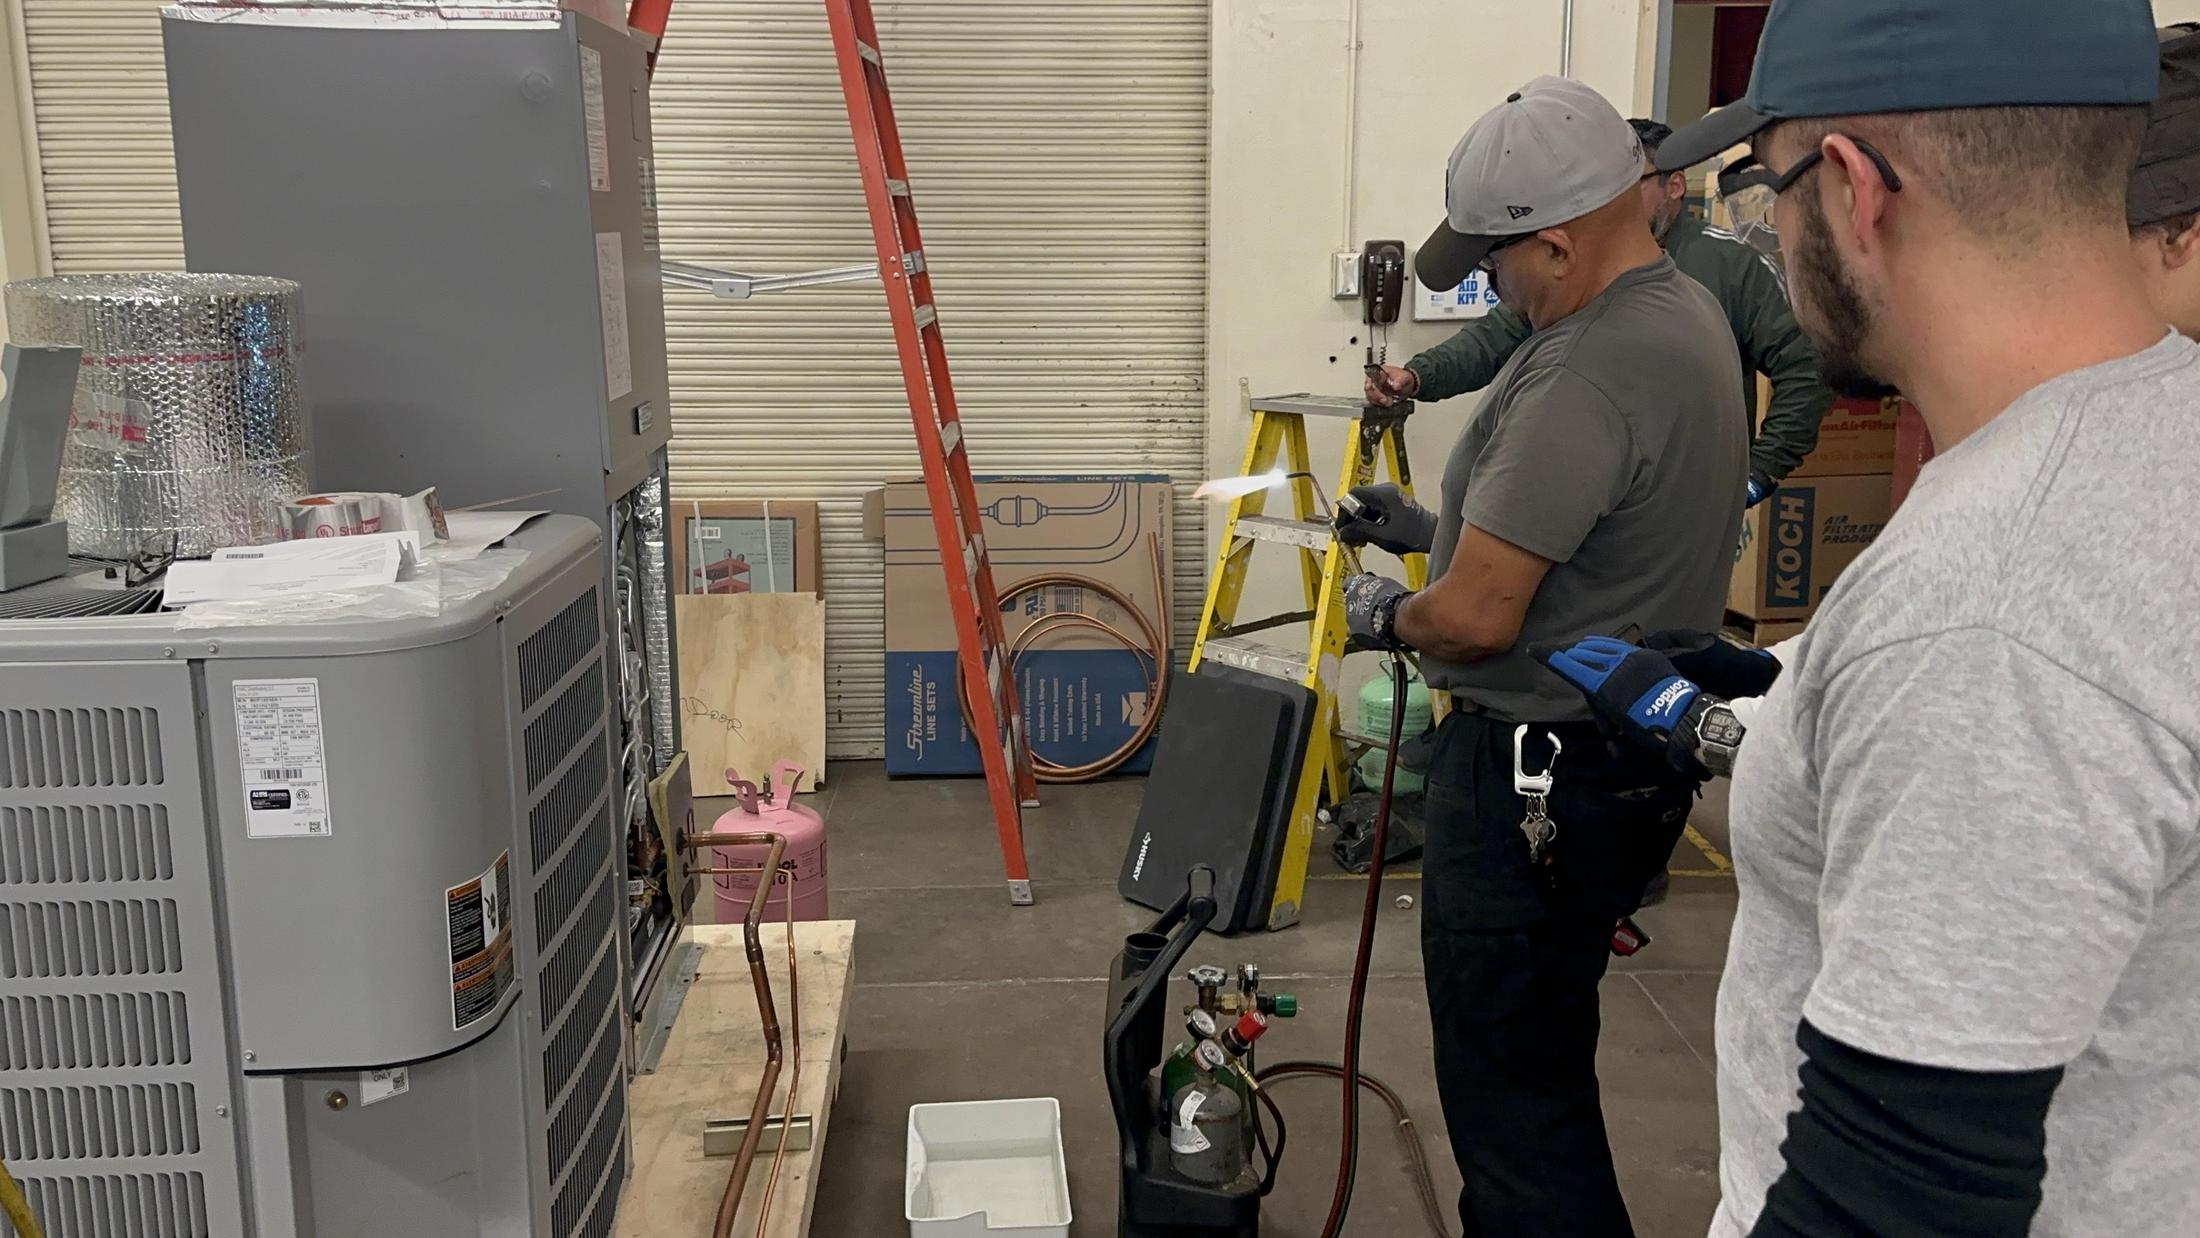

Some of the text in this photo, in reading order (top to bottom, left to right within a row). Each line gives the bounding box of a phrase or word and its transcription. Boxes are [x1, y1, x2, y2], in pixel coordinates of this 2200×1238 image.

[1458, 280, 1478, 292] AID
[1457, 293, 1478, 305] KIT
[1824, 515, 1849, 525] AIR
[1776, 495, 1805, 599] KOCH
[907, 664, 923, 761] Streamline
[926, 682, 937, 742] LINE SETS
[1132, 845, 1149, 882] HUSKY
[373, 1070, 392, 1082] ONLY
